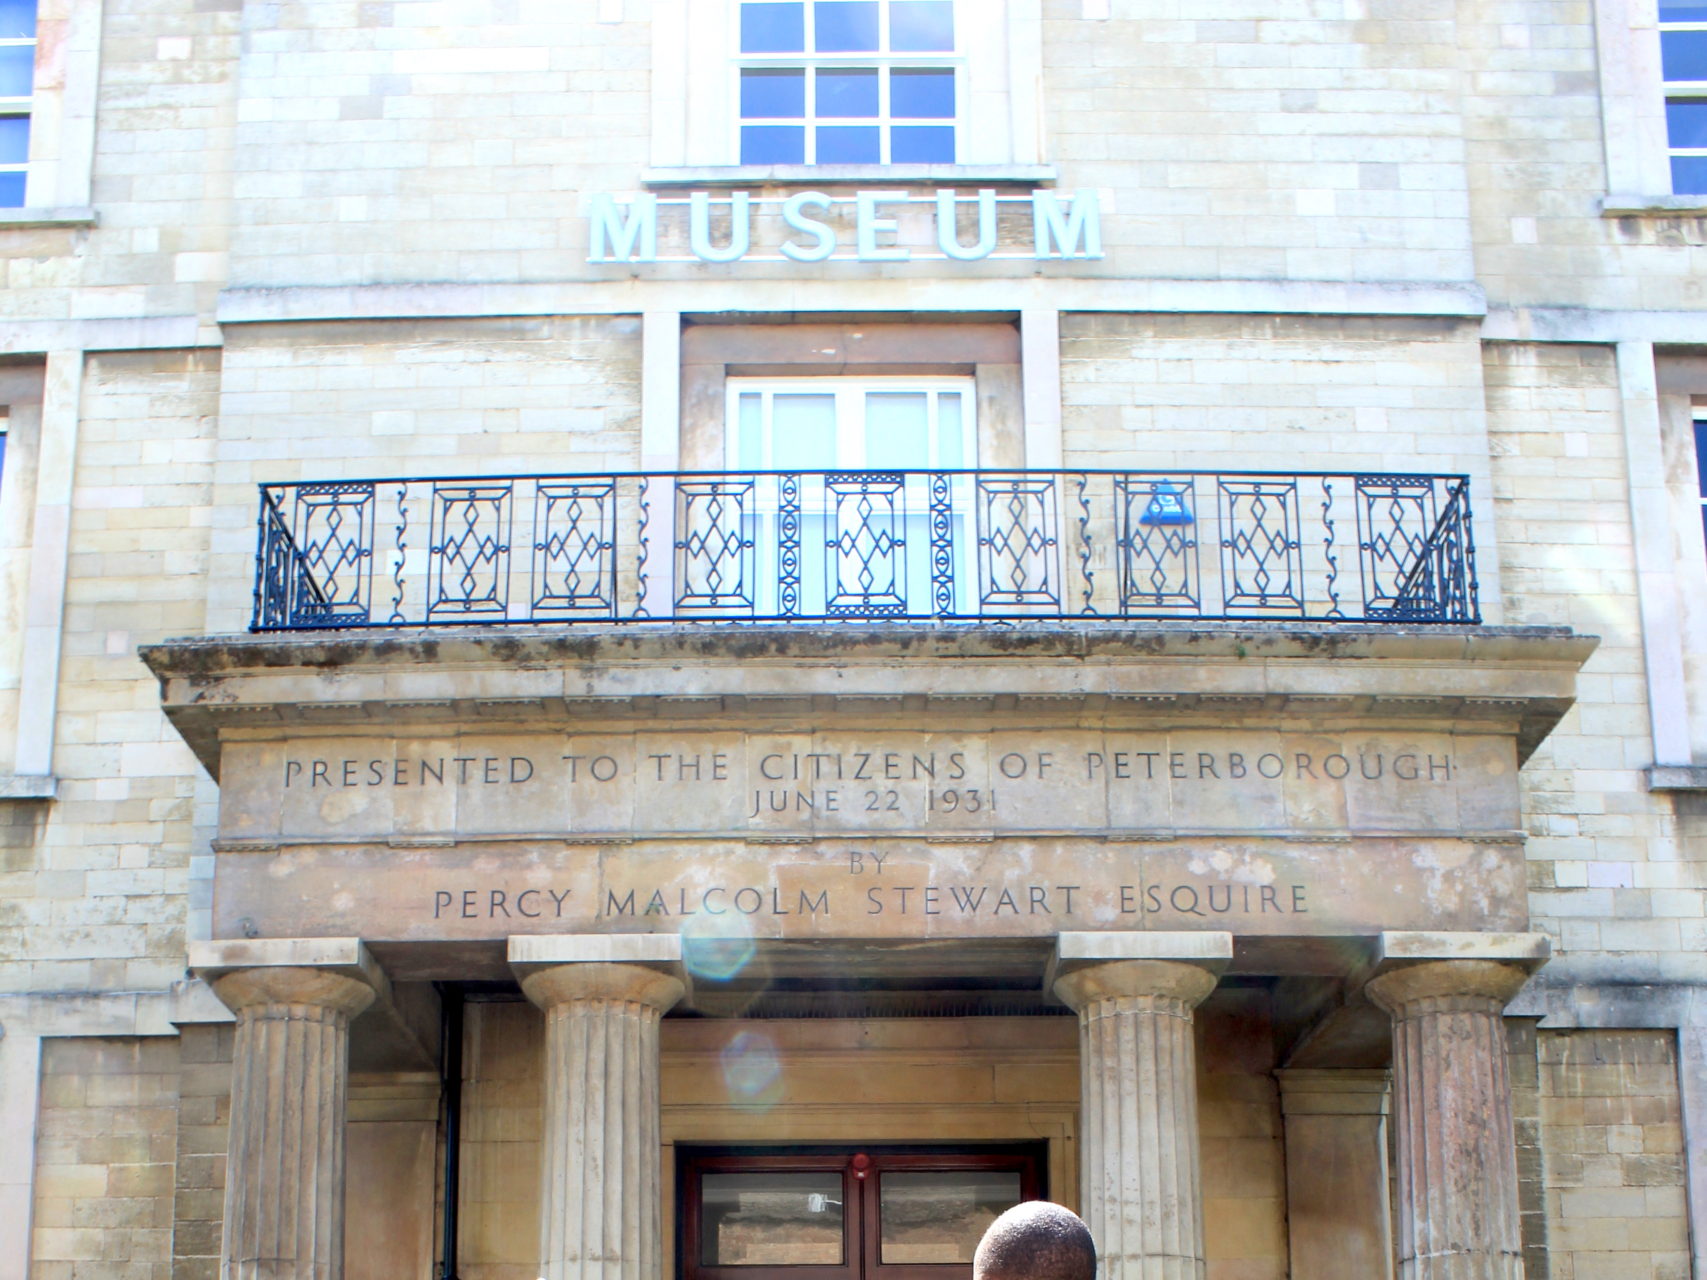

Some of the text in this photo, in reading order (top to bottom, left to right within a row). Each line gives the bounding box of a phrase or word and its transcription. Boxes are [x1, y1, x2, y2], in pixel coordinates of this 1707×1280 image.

[587, 188, 1103, 264] MUSEUM
[285, 752, 1453, 789] PRESENTED TO THE CITIZENS OF PETERBOROUGH
[751, 789, 997, 817] JUNE 22 1931
[850, 851, 889, 876] BY
[435, 884, 1309, 920] PERCY MALCOLM STEWART ESQUIRE
